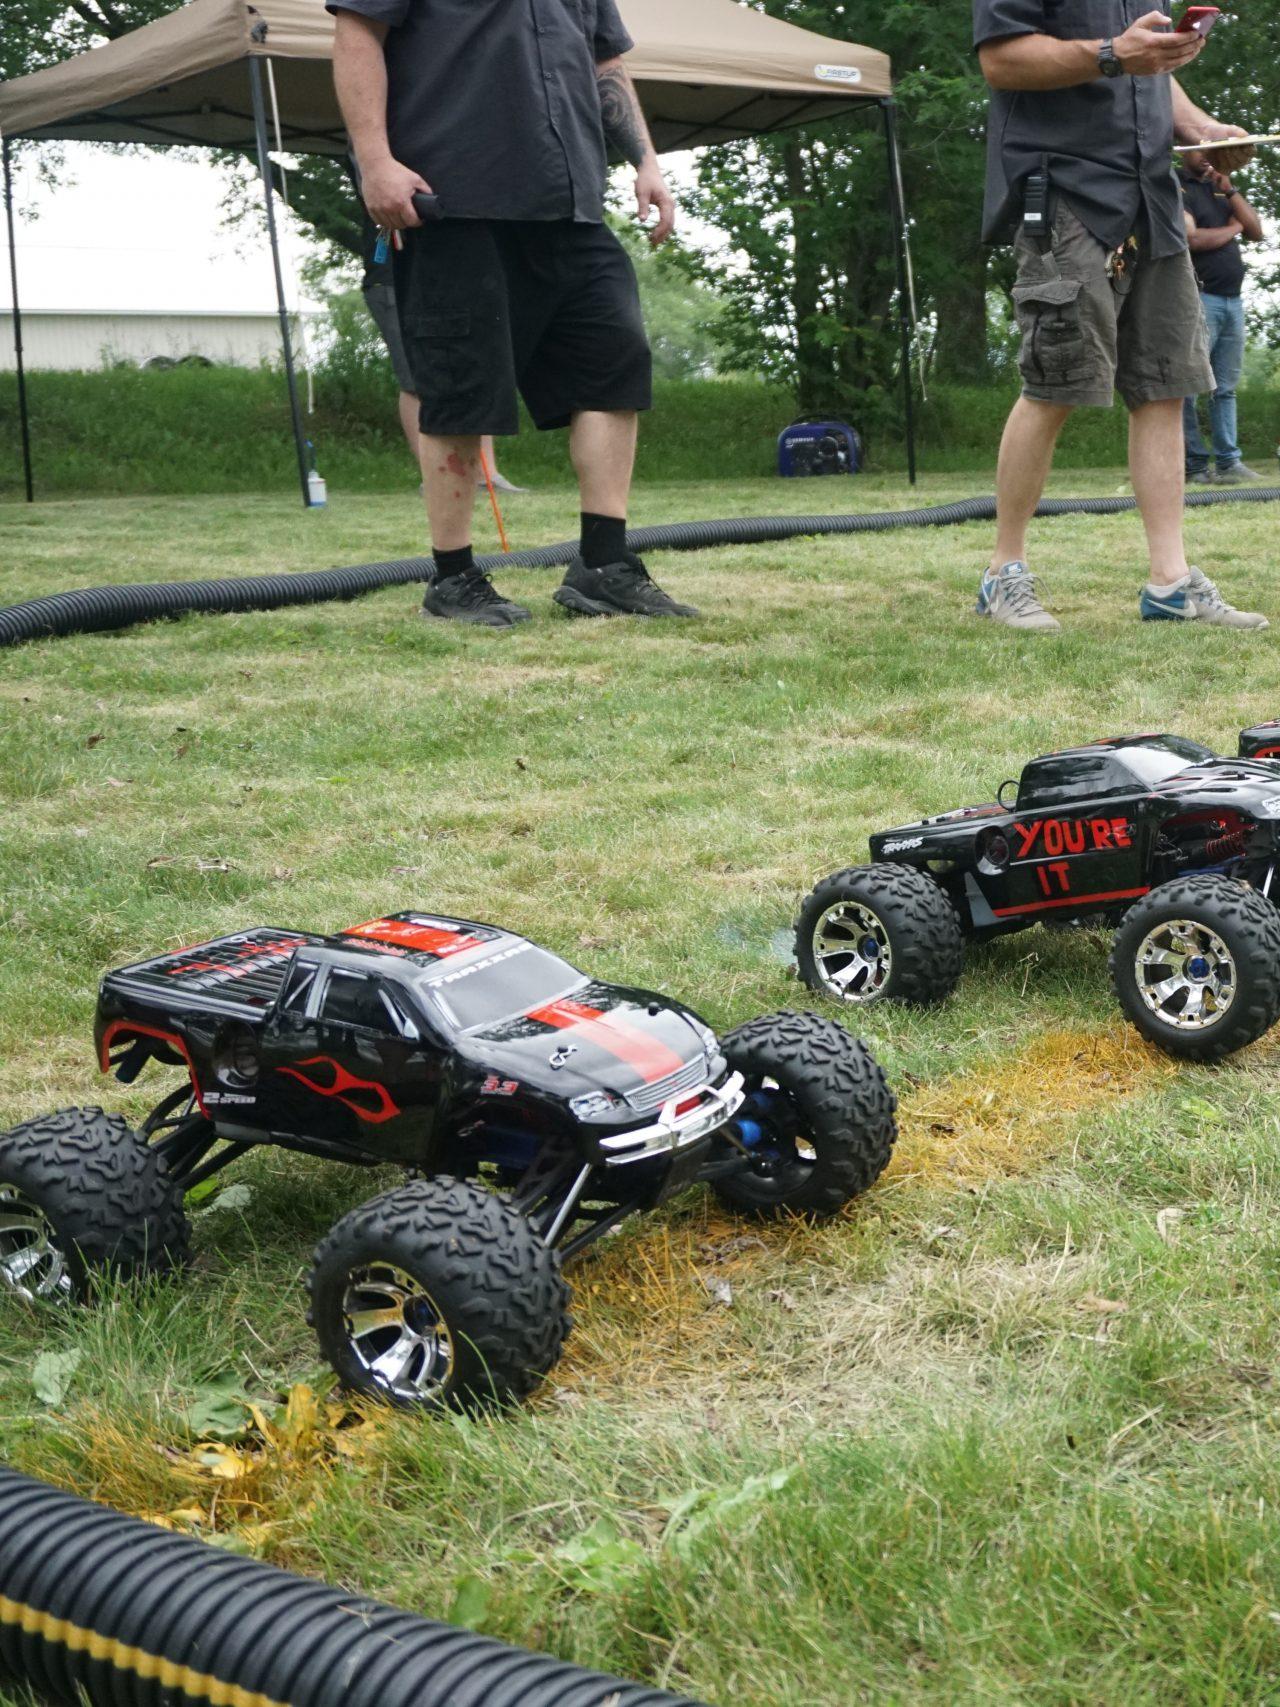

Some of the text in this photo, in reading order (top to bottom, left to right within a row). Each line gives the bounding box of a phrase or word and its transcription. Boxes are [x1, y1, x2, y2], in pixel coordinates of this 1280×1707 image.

[1013, 817, 1131, 858] YOU'RE
[1036, 861, 1070, 896] IT
[202, 1091, 220, 1104] 2
[220, 1096, 256, 1104] SPEED
